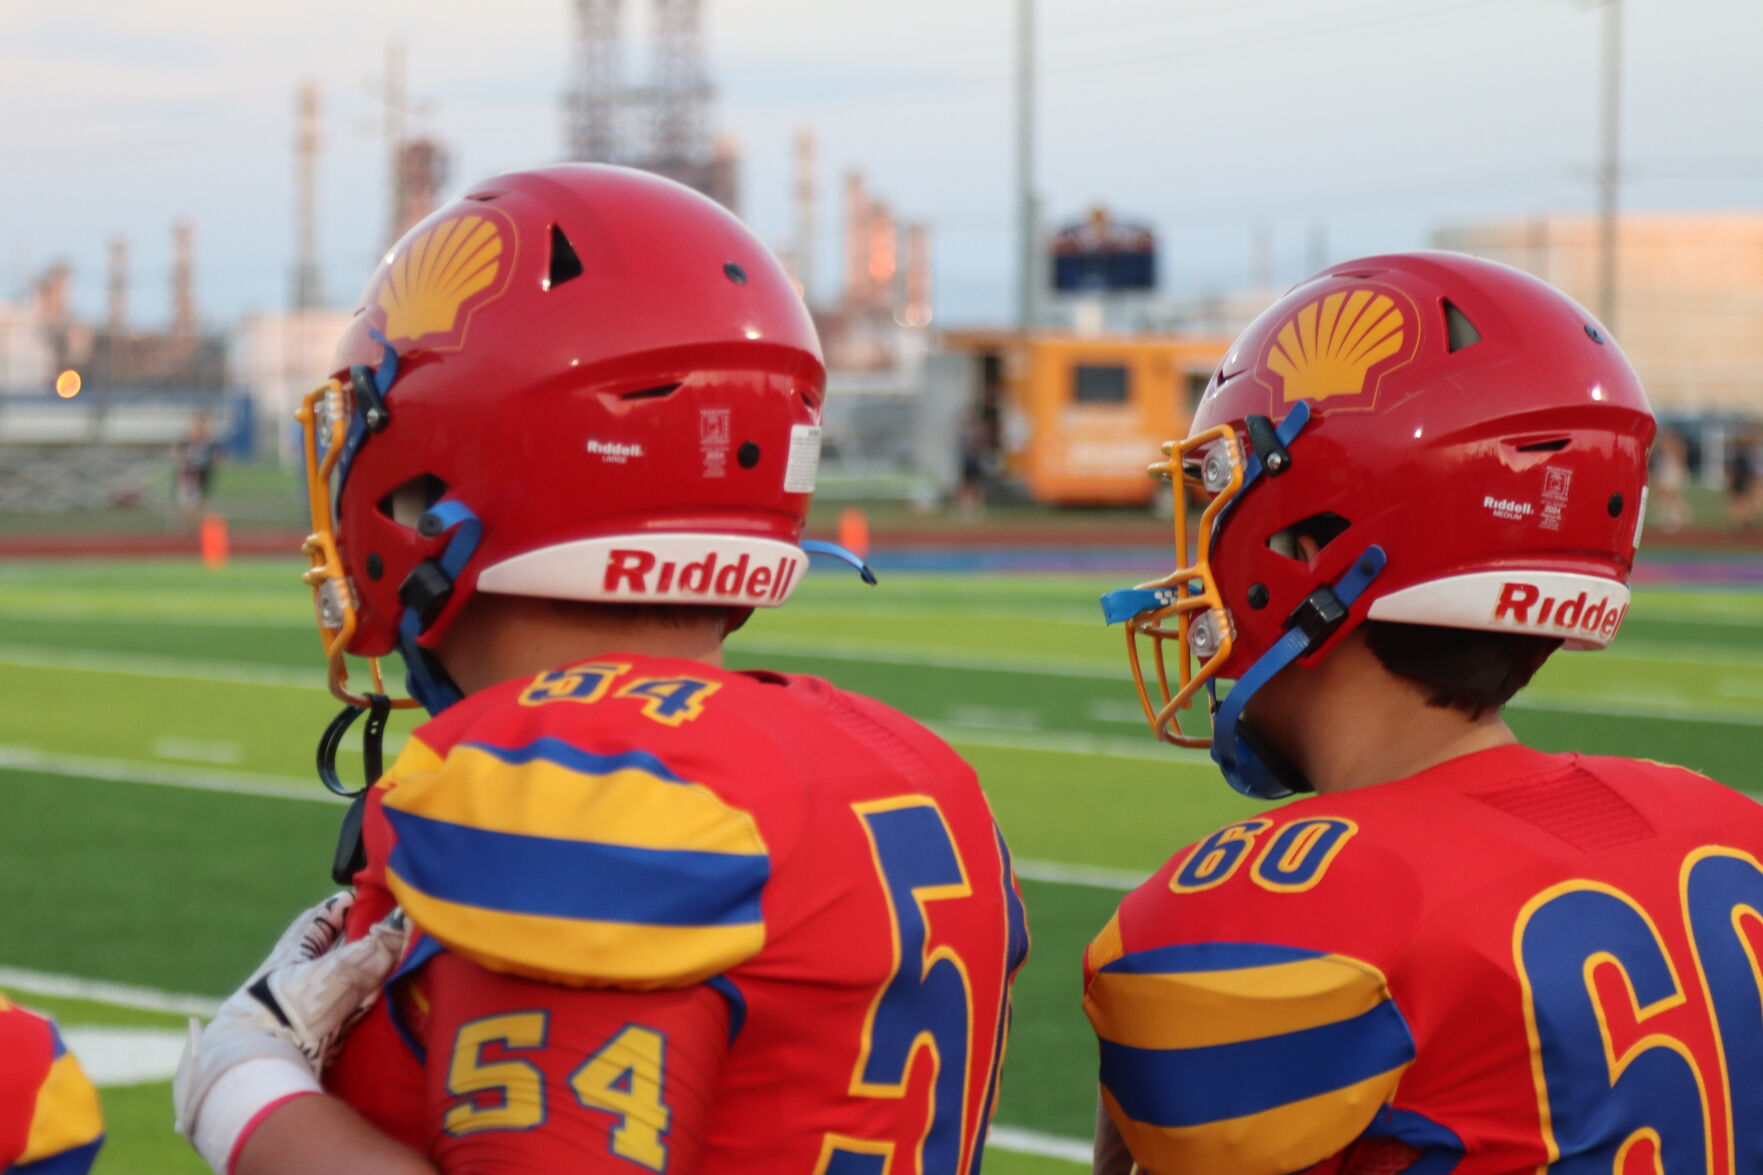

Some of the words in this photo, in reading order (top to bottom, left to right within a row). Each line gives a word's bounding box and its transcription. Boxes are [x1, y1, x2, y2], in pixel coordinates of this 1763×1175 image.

[587, 439, 644, 457] Riddell
[1483, 496, 1534, 515] Riddell
[1493, 510, 1523, 521] MEDIUM
[603, 549, 797, 601] Riddell
[518, 661, 723, 727] 54
[1169, 815, 1359, 894] 60
[812, 793, 1025, 1175] 5
[443, 1009, 672, 1175] 54
